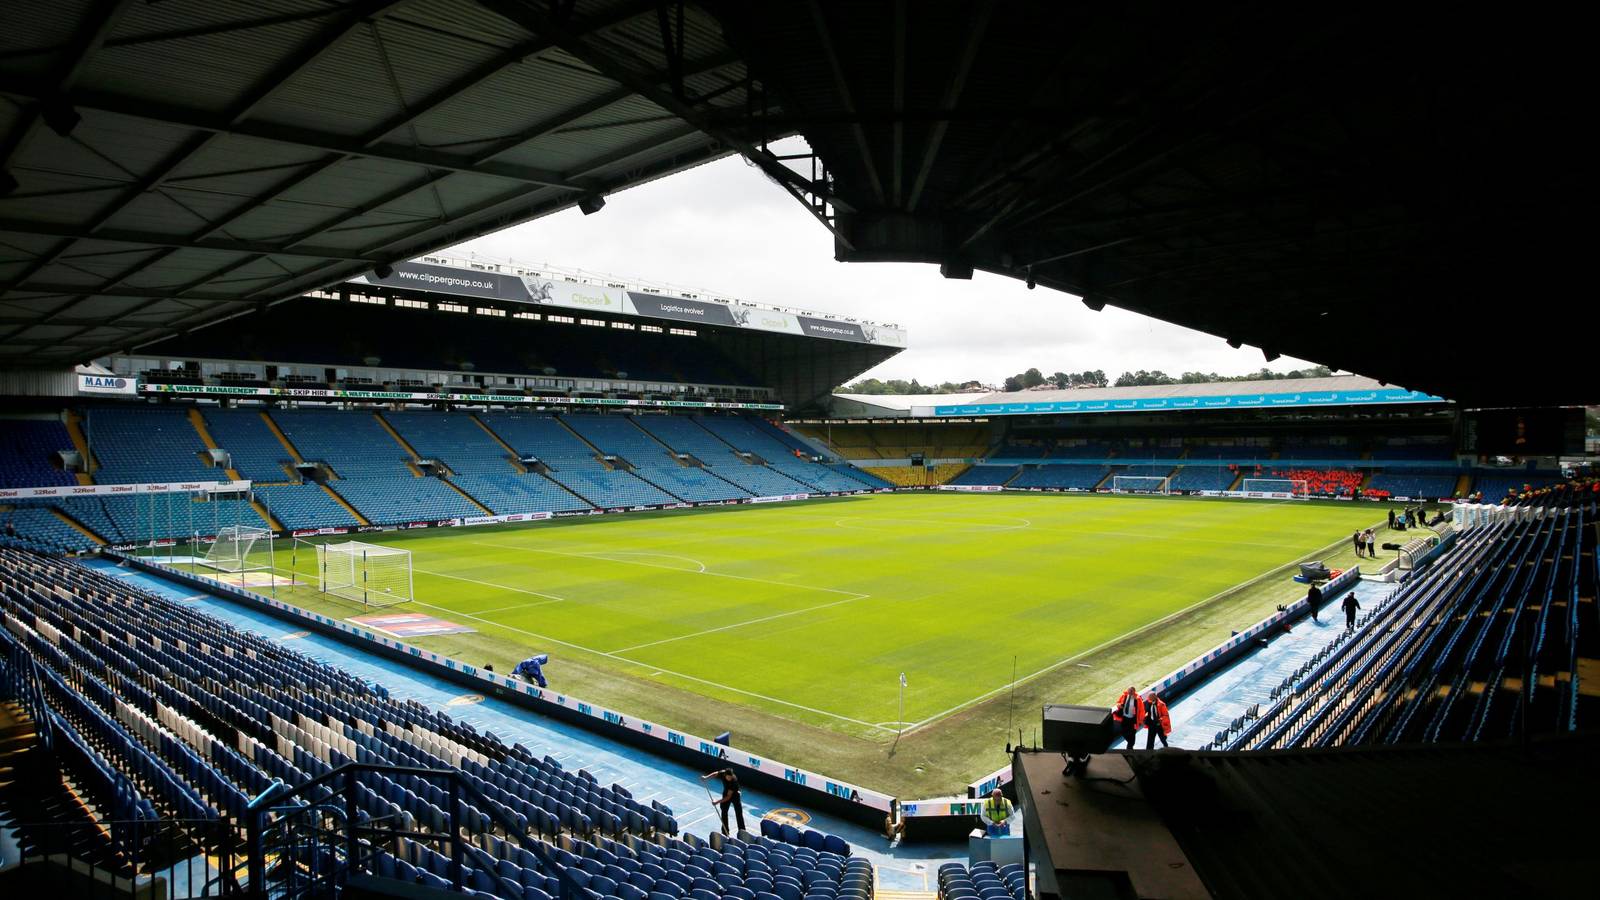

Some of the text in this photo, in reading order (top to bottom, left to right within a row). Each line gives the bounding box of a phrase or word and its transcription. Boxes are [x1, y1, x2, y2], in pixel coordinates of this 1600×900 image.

[398, 271, 494, 289] www.clippergroup.co.uk
[659, 303, 705, 317] Logistics evolved
[206, 386, 258, 394] MANAGEMENT
[372, 391, 413, 399] MANAGEMENT
